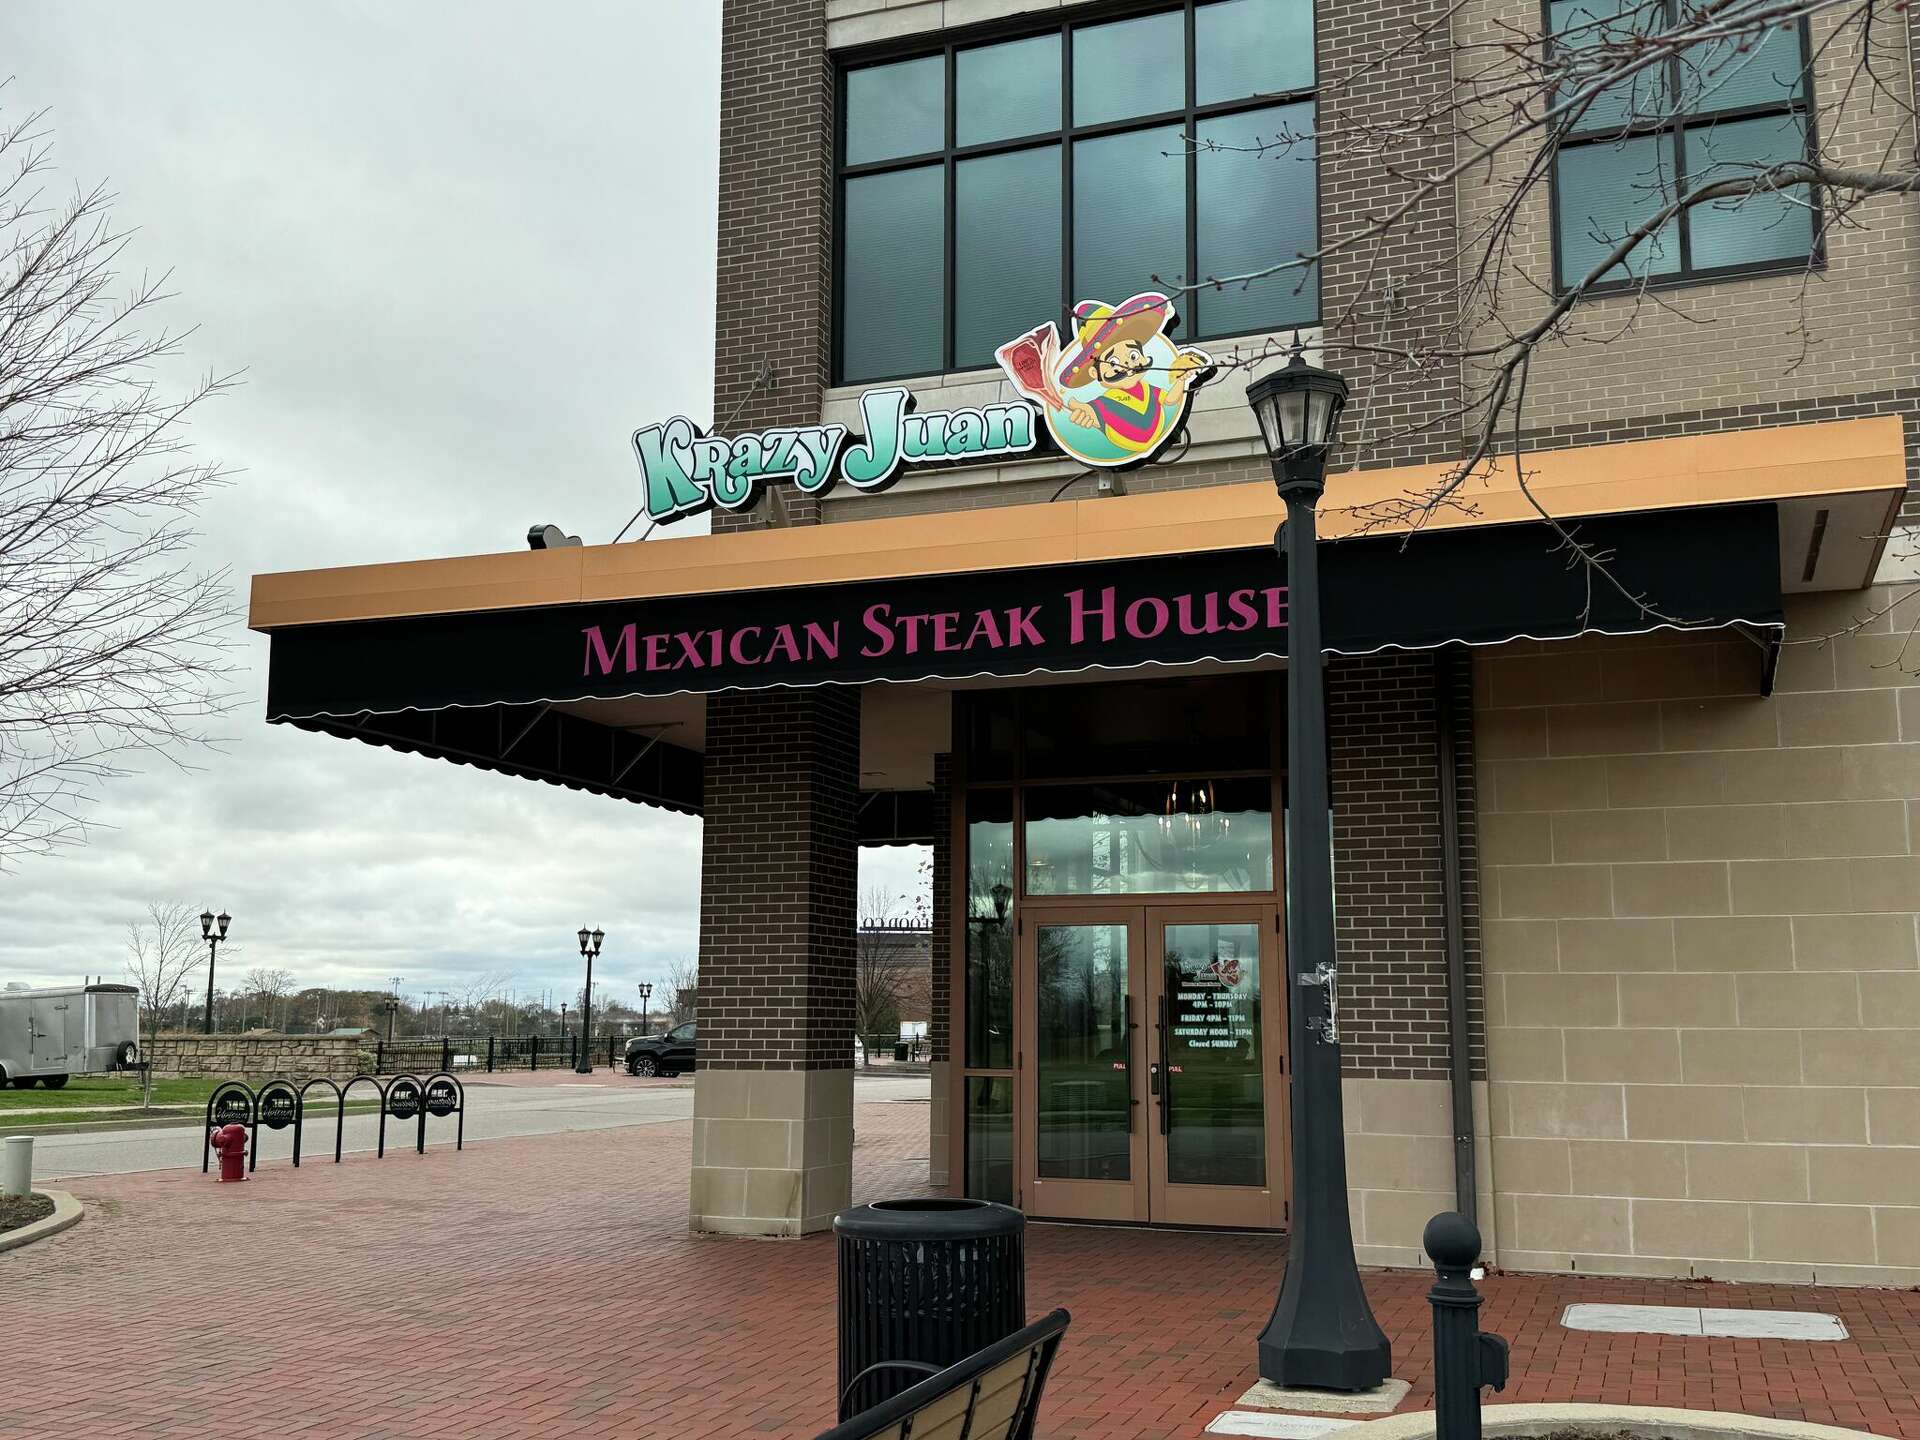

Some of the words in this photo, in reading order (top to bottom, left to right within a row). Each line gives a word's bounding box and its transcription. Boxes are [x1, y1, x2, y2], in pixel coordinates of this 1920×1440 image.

[844, 391, 1032, 483] Juan
[581, 620, 840, 677] MEXICAN
[860, 603, 1046, 657] STEAK
[1177, 992, 1206, 1000] MONDAY
[1212, 992, 1248, 1000] THURSDAY
[1180, 1014, 1205, 1022] FRIDAY
[1206, 1014, 1222, 1022] 4PM
[1174, 1028, 1208, 1036] SATURDAY
[1209, 1028, 1229, 1036] NOON
[1188, 1040, 1210, 1048] Closed
[1211, 1040, 1239, 1048] SUNDAY
